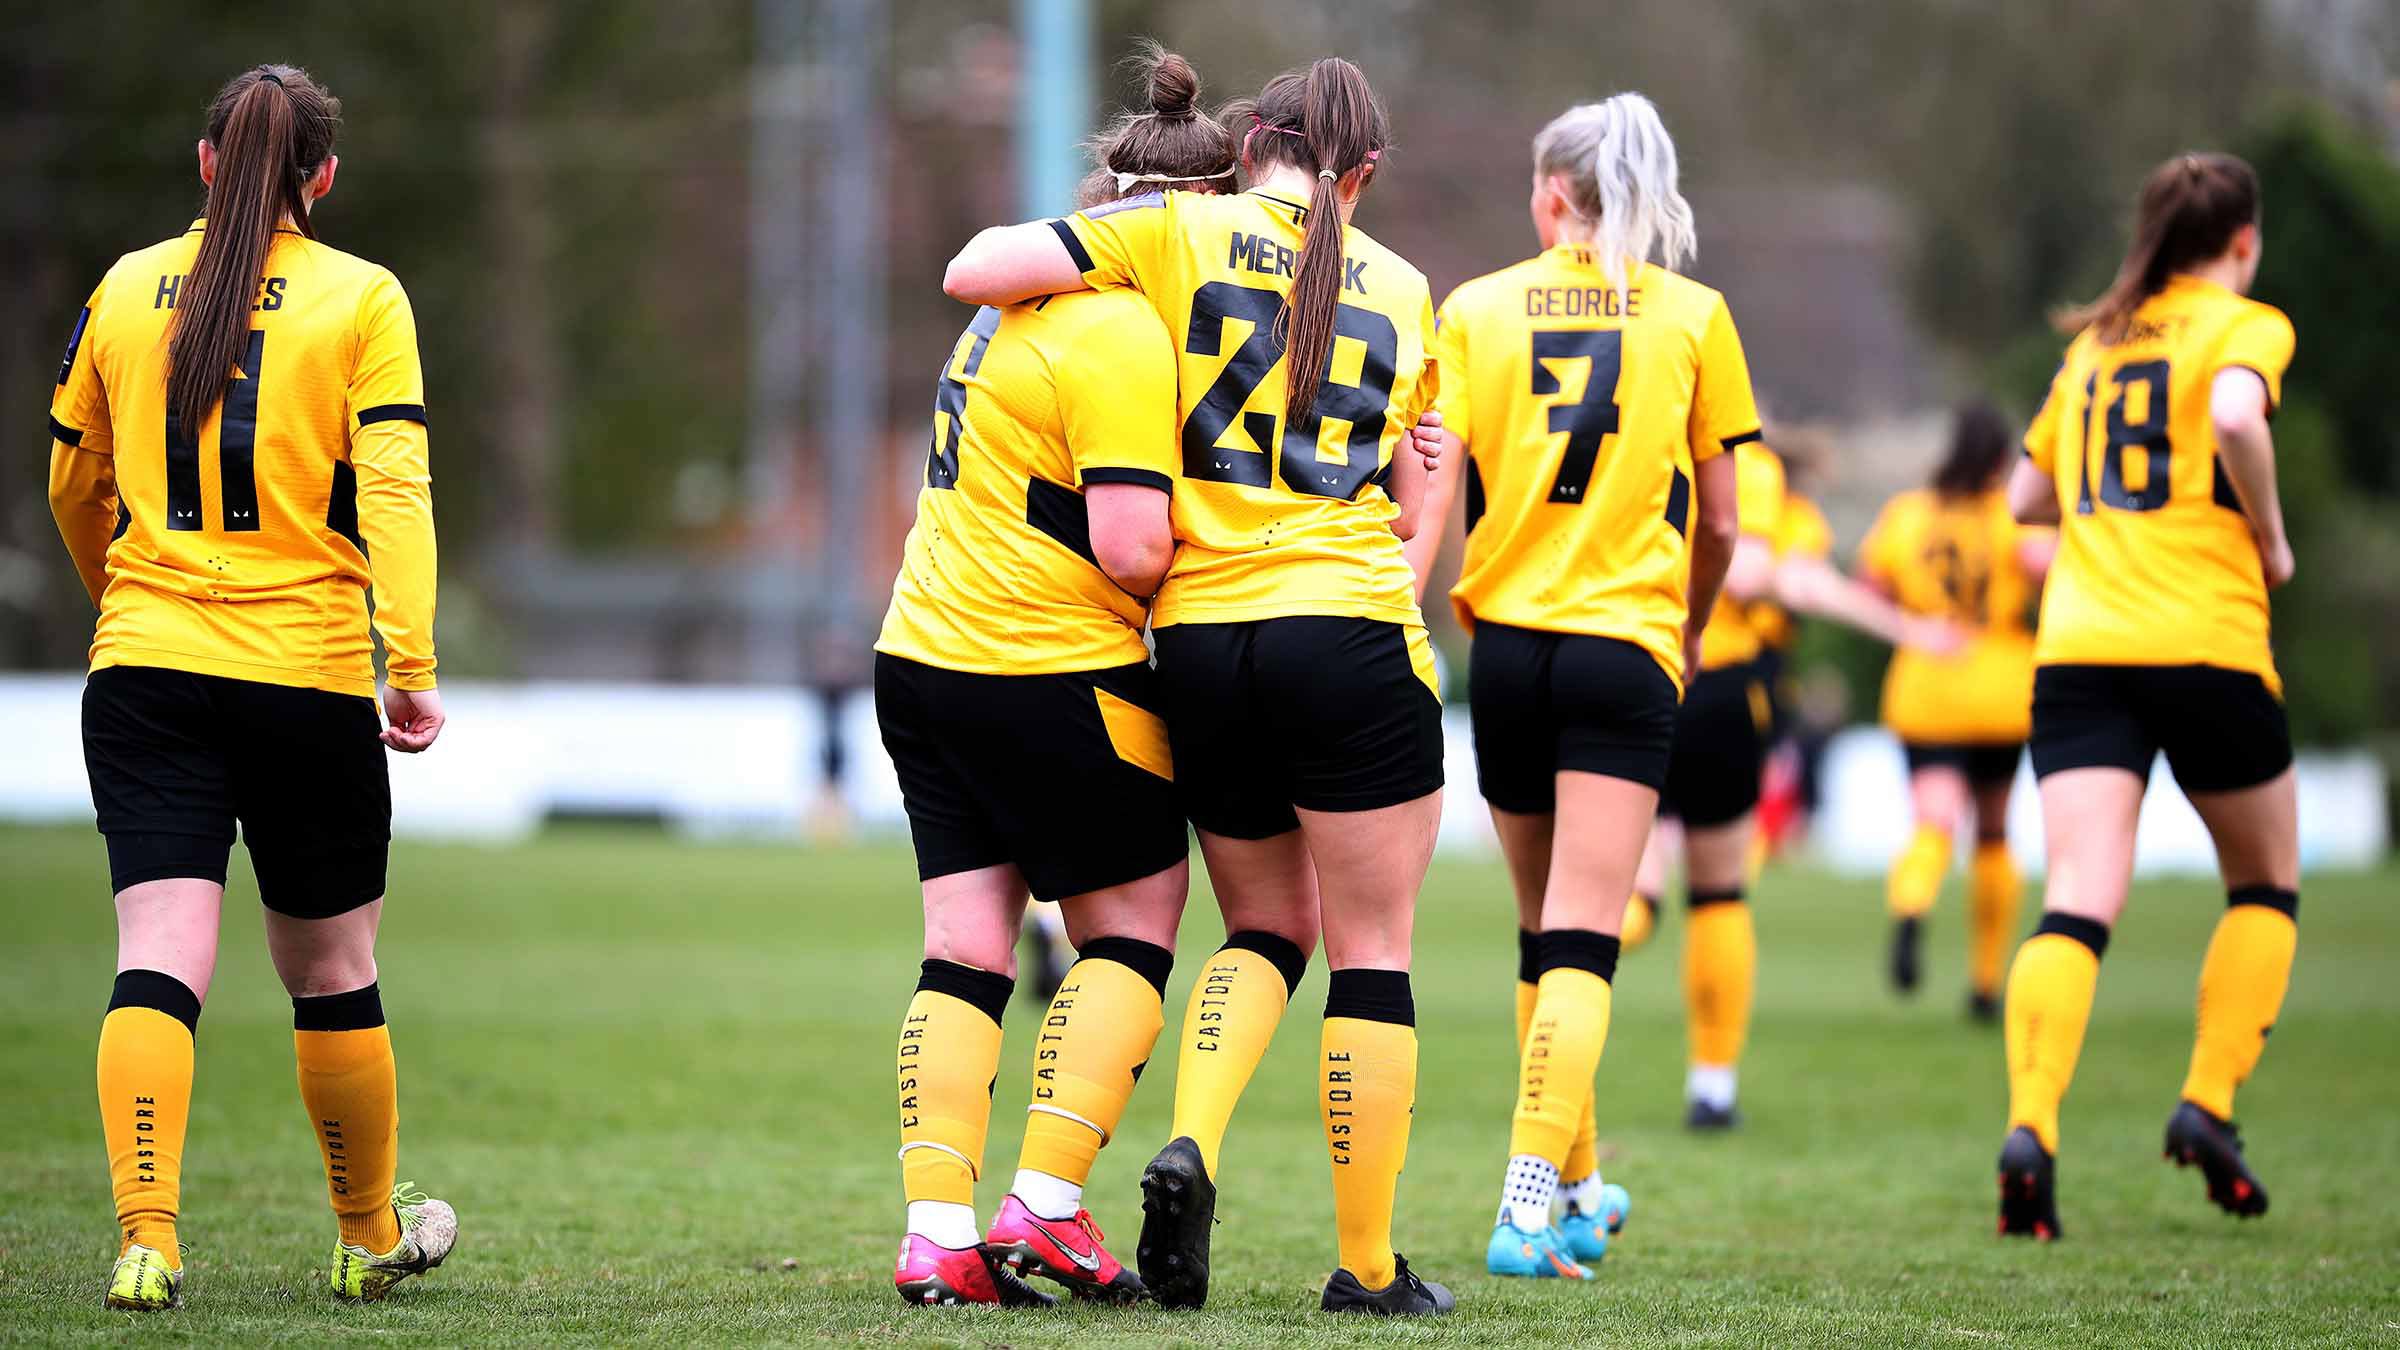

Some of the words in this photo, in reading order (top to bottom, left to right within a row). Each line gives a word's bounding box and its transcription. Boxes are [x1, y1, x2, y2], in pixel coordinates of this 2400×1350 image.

[1527, 287, 1642, 317] GEORGE
[166, 330, 265, 532] 11
[1181, 281, 1398, 501] 28
[1531, 328, 1621, 505] 7
[2076, 359, 2171, 514] 18
[1036, 984, 1081, 1100] CASTORE
[1197, 964, 1239, 1052] CASTORE
[901, 1013, 929, 1129] CASTORE
[1328, 1051, 1352, 1165] CASTORE
[136, 1096, 155, 1183] CASTORE
[322, 1119, 348, 1195] CASTORE
